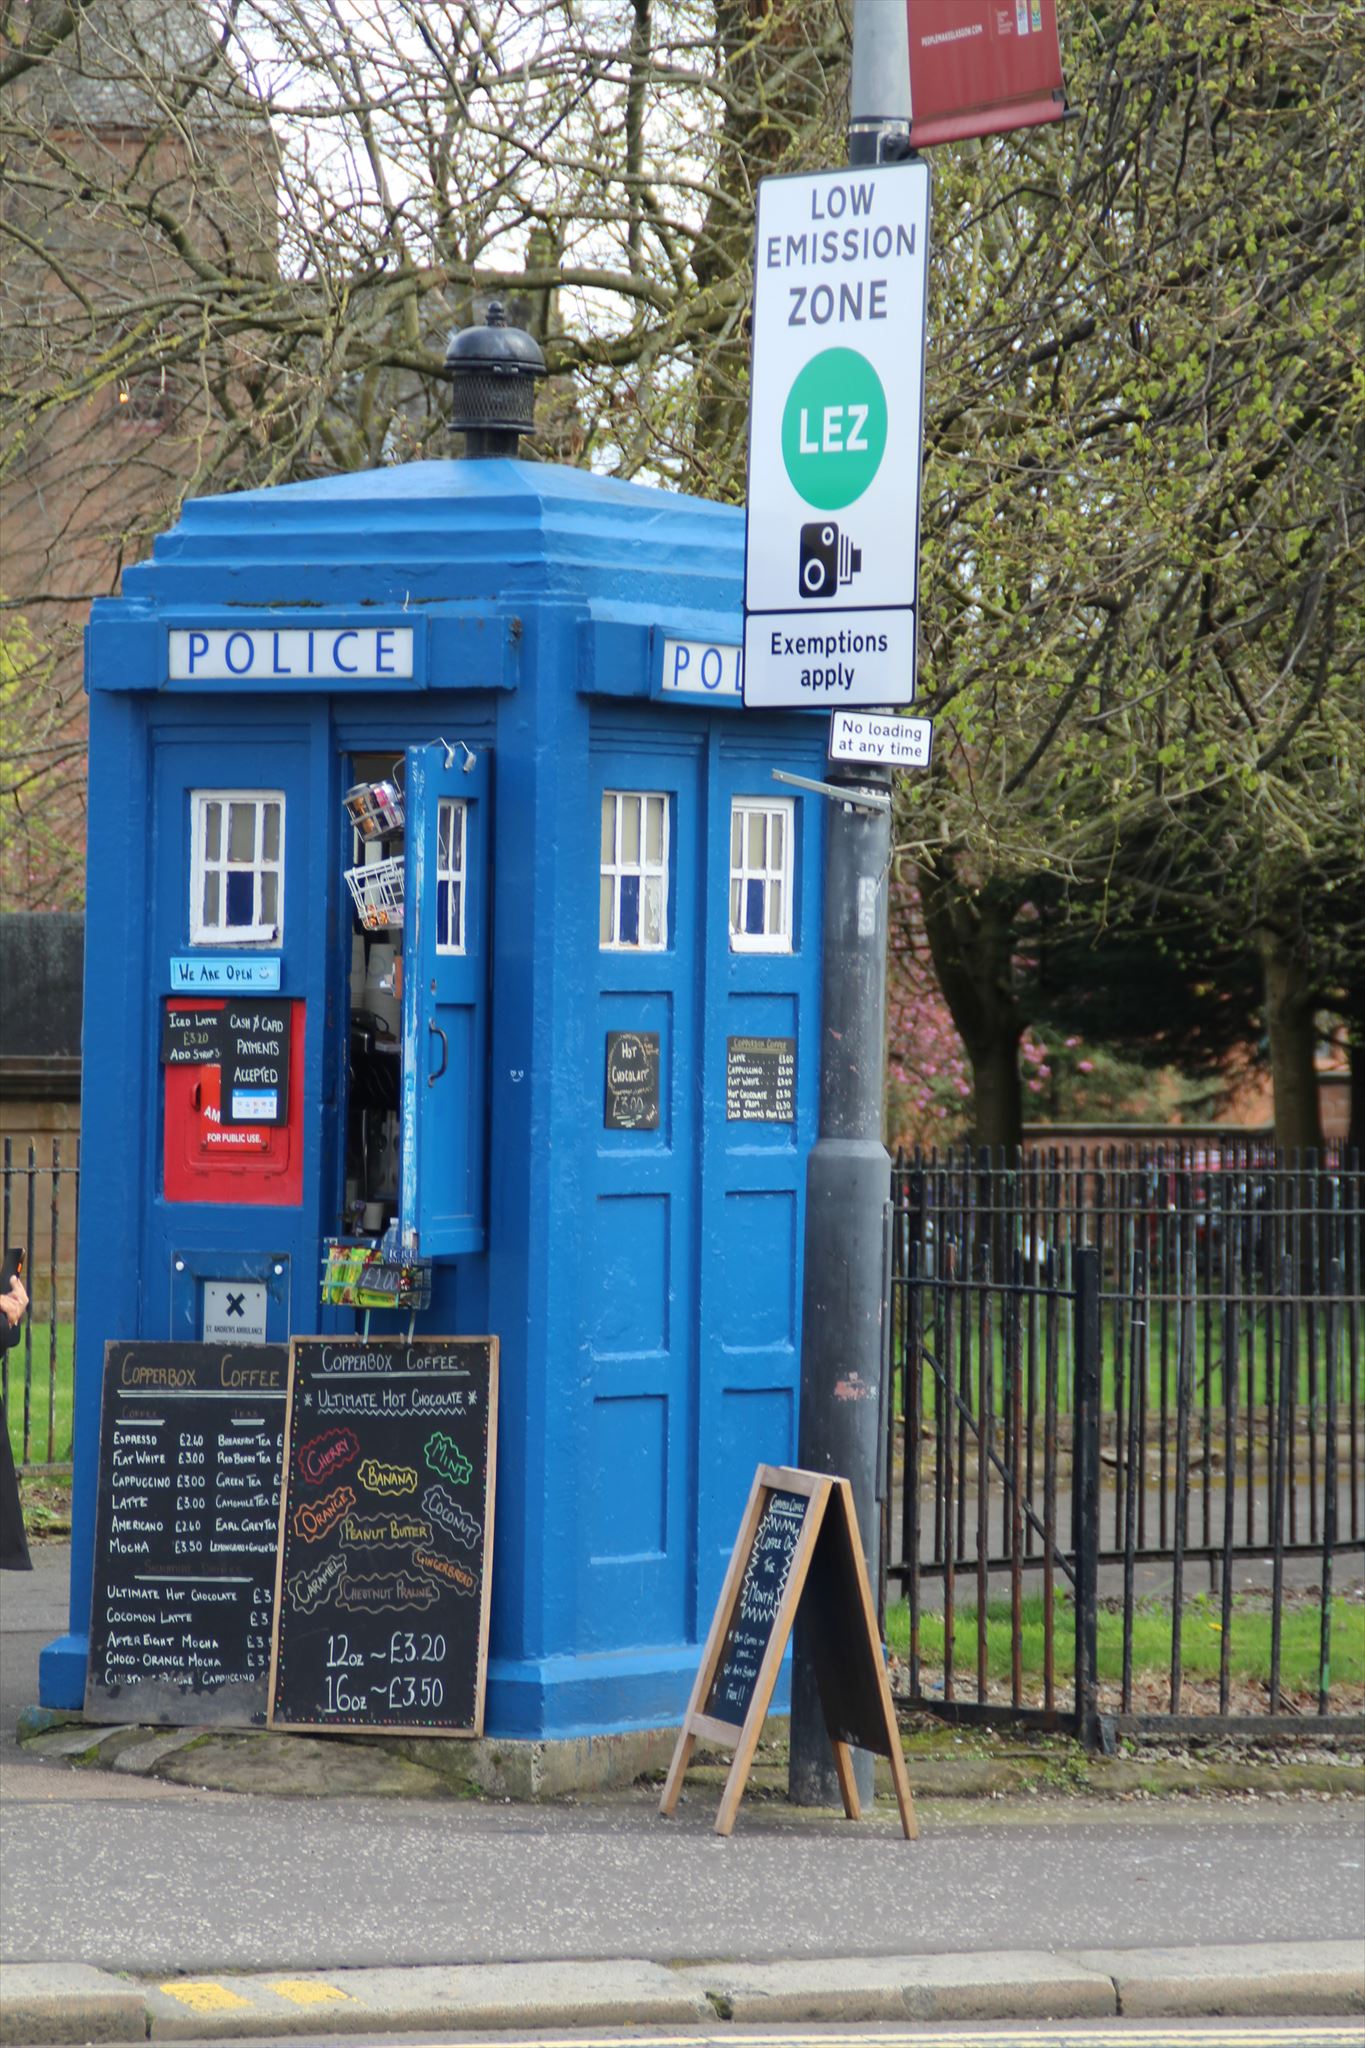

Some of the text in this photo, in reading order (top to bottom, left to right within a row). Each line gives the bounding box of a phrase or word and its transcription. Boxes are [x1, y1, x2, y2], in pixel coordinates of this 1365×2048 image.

[811, 183, 875, 220] LOW
[766, 224, 916, 268] EMISSION
[788, 280, 888, 326] ZONE
[799, 404, 869, 454] LEZ
[188, 631, 395, 674] POLICE
[771, 630, 888, 658] Exemptions
[800, 663, 855, 690] apply
[843, 719, 922, 742] No loading
[839, 738, 922, 757] at any time
[237, 1039, 279, 1056] PAYMENTS
[234, 1066, 278, 1083] ACCEPTED
[207, 1133, 221, 1143] FOR
[222, 1133, 245, 1143] PUBLIC
[122, 1352, 279, 1388] COPPERBOX COFFEE
[322, 1346, 458, 1372] COPPERBOX COFFEE
[318, 1388, 463, 1408] ULTIMATE HOT CHOCOLATE
[113, 1431, 157, 1446] ESPRESSO
[113, 1449, 133, 1466] FLAT
[136, 1451, 166, 1465] WHITE
[306, 1438, 350, 1477] CHERRY
[432, 1440, 467, 1477] MINT
[112, 1472, 170, 1489] CAPPUCCINO
[216, 1472, 244, 1488] GREEN
[246, 1474, 261, 1487] TEA
[368, 1465, 413, 1486] BANANA
[112, 1494, 148, 1509] LATTE
[112, 1515, 164, 1533] AMERICANO
[302, 1493, 348, 1533] ORANGE
[429, 1493, 477, 1539] COCONUT
[216, 1518, 239, 1532] EARL
[241, 1518, 264, 1531] GREY
[345, 1520, 428, 1541] PEANUT BUTTER
[109, 1538, 150, 1554] MOCHA
[416, 1551, 474, 1588] GINGERBREAD
[296, 1560, 344, 1603] CARAMEL
[342, 1576, 433, 1600] CHESTNUT PRALINE
[107, 1585, 160, 1599] ULTIMATE
[166, 1588, 185, 1600] HOT
[191, 1589, 238, 1601] CHOCOLATE
[161, 1611, 192, 1623] LATTE
[107, 1631, 141, 1648] AFTER
[143, 1634, 174, 1646] EIGHT
[182, 1634, 219, 1648] MOCHA
[391, 1631, 446, 1664] £3.20
[189, 1652, 221, 1667] MOCHA
[389, 1676, 444, 1709] £3.50
